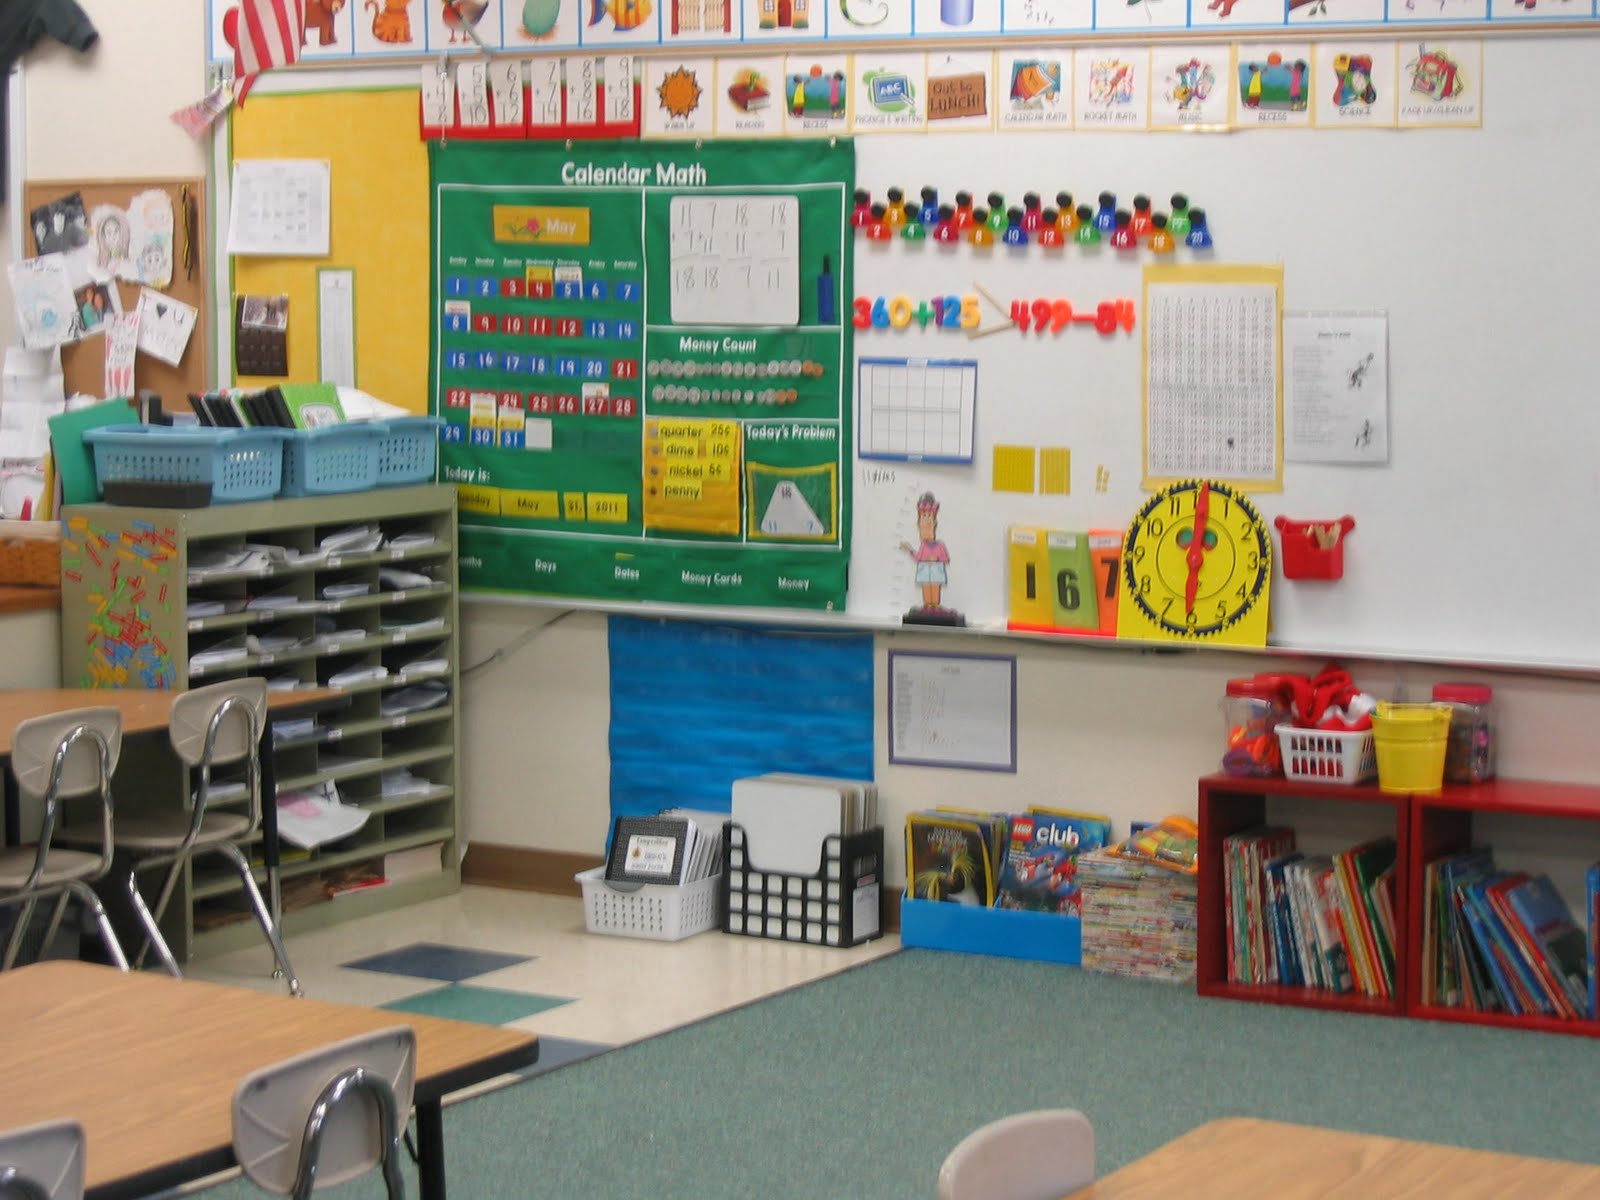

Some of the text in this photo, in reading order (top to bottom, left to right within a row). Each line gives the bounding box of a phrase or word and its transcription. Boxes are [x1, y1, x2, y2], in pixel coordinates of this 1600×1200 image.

[472, 64, 483, 84] 5
[506, 64, 517, 82] 6
[548, 62, 557, 82] 7
[582, 60, 593, 79] 8
[619, 57, 630, 76] 9
[583, 80, 593, 98] 8
[619, 78, 629, 98] 9
[880, 82, 902, 97] ABC
[933, 81, 956, 95] Out
[469, 104, 487, 123] 10
[502, 104, 519, 122] 12
[542, 103, 557, 121] 14
[576, 101, 593, 119] 16
[614, 100, 630, 118] 18
[561, 160, 707, 187] Calendar Math
[546, 218, 577, 236] May
[873, 224, 881, 238] 2
[891, 210, 898, 222] 3
[924, 209, 932, 221] 5
[941, 226, 948, 239] 6
[959, 213, 966, 225] 7
[993, 215, 1000, 228] 9
[1008, 229, 1020, 243] 10
[1028, 215, 1037, 228] 11
[1044, 231, 1055, 244] 12
[1061, 215, 1072, 227] 13
[1099, 215, 1110, 227] 15
[1116, 232, 1128, 245] 16
[1134, 218, 1147, 231] 17
[482, 280, 489, 296] 2
[509, 280, 517, 296] 3
[536, 282, 544, 298] 4
[564, 283, 571, 298] 5
[592, 283, 600, 298] 6
[624, 284, 632, 300] 7
[482, 316, 489, 331] 9
[507, 318, 520, 334] 10
[533, 318, 546, 334] 11
[562, 320, 576, 336] 12
[592, 322, 605, 337] 13
[618, 323, 631, 338] 14
[679, 336, 757, 355] Money Count
[452, 352, 631, 377] 15 16 17 18 19 20 21
[451, 391, 631, 415] 22 24 25 26 27 28
[445, 426, 519, 446] 29 30 31
[660, 427, 702, 442] quarter
[745, 423, 837, 442] Today's Problem
[666, 443, 695, 457] dime
[444, 465, 475, 484] Today
[669, 463, 703, 477] nickel
[664, 484, 700, 500] penny
[517, 498, 540, 512] May
[595, 501, 619, 513] 2011
[1169, 497, 1181, 517] 11
[1145, 518, 1163, 537] 10
[1241, 522, 1253, 541] 2
[1134, 546, 1145, 564] 9
[1248, 551, 1258, 570] 3
[614, 566, 640, 580] Dates
[681, 570, 743, 587] Money Cards
[778, 577, 810, 592] Money
[1025, 557, 1119, 610] 1 6 7
[1141, 575, 1151, 594] 8
[1236, 582, 1247, 599] 4
[1161, 597, 1175, 616] 7
[1215, 600, 1227, 619] 5
[1013, 823, 1033, 835] LEGO
[1036, 823, 1080, 848] club
